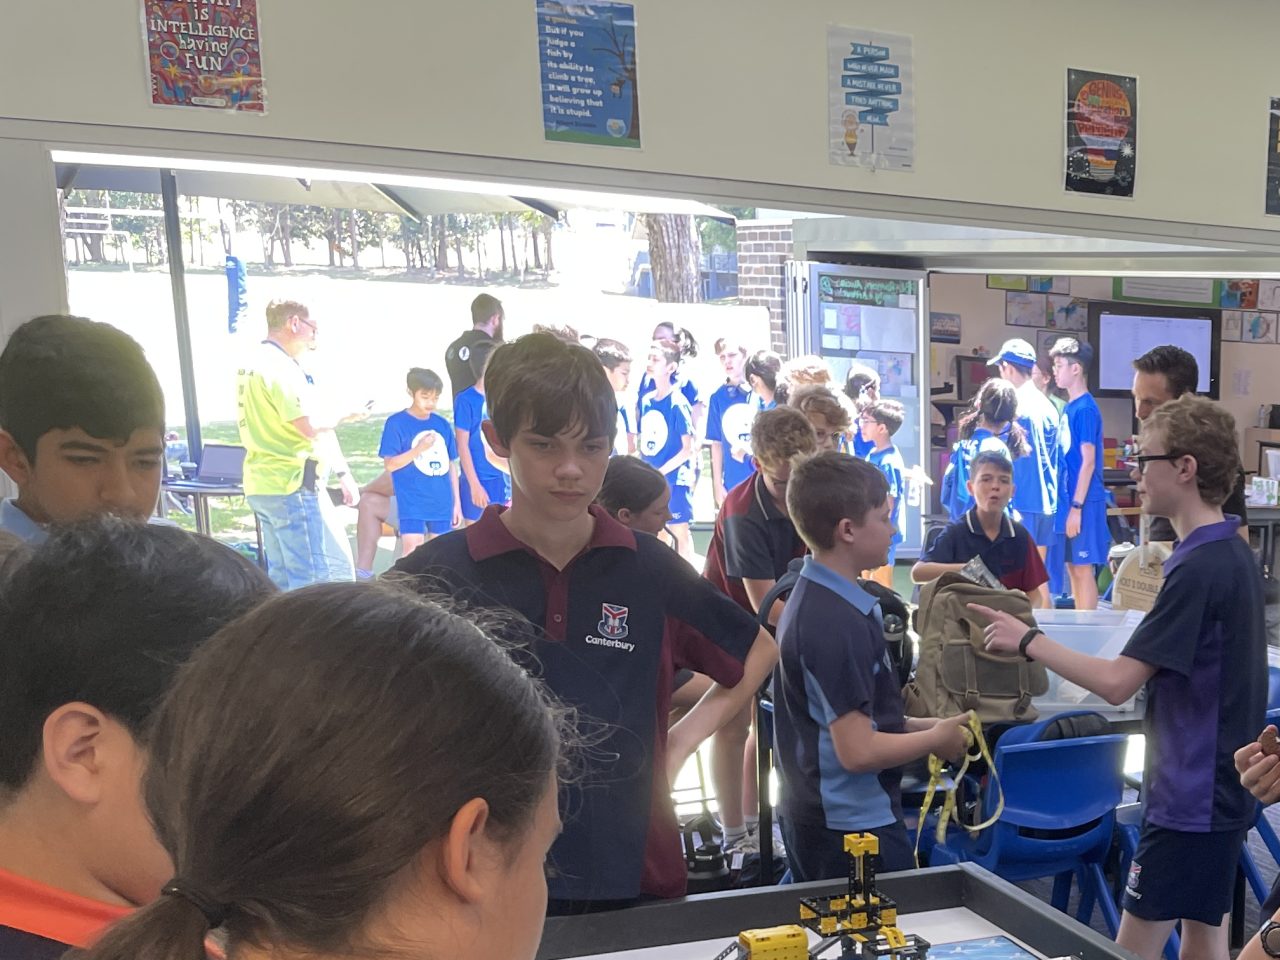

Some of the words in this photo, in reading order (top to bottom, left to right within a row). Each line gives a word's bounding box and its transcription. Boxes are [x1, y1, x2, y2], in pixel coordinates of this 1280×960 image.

[194, 4, 209, 20] is
[150, 20, 256, 40] INTELLIGENCE
[545, 26, 560, 34] But
[569, 30, 584, 38] you
[179, 34, 228, 56] having
[185, 54, 222, 71] FUN
[562, 50, 573, 60] by
[586, 98, 603, 107] that
[585, 635, 635, 652] Canterbury
